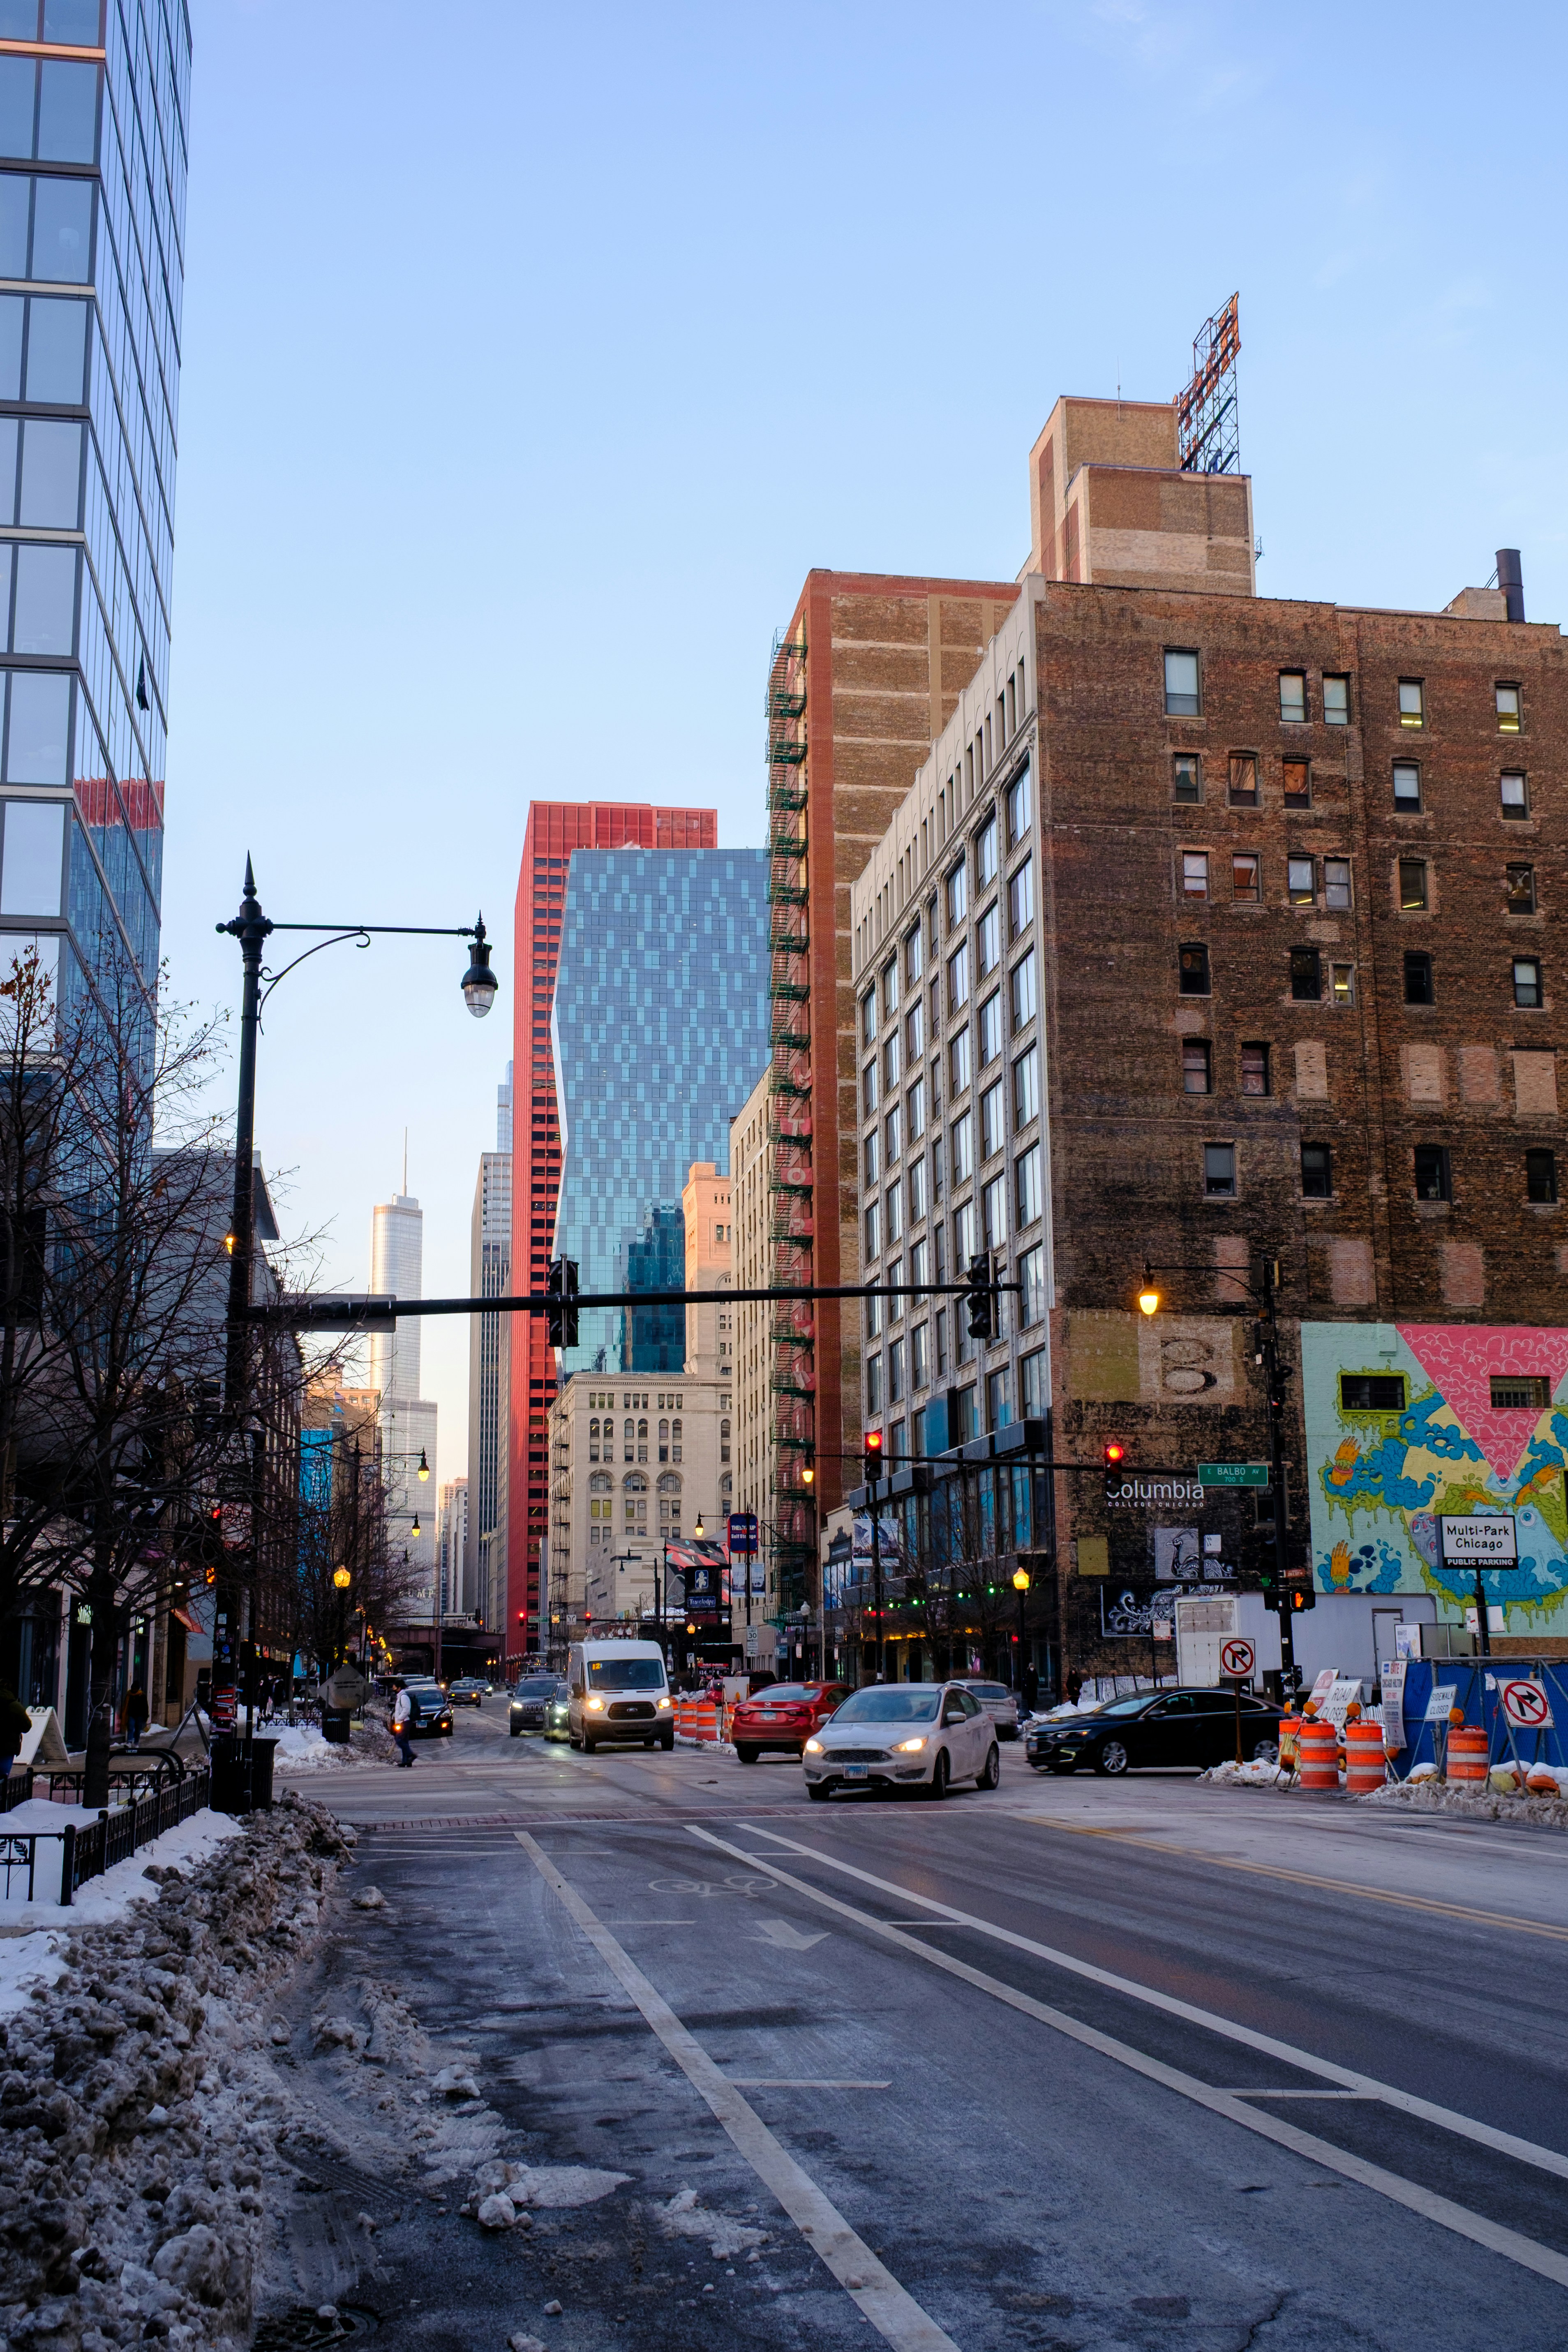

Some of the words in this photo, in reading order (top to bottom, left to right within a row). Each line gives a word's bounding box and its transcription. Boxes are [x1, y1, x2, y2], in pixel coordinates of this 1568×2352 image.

[1447, 1525, 1510, 1536] Multi-Park
[1456, 1538, 1503, 1551] Chicago
[1390, 1663, 1399, 1675] GATE
[1331, 1687, 1352, 1701] ROAD
[1430, 1691, 1454, 1701] SIDEWALK
[1430, 1705, 1449, 1715] CLOSED
